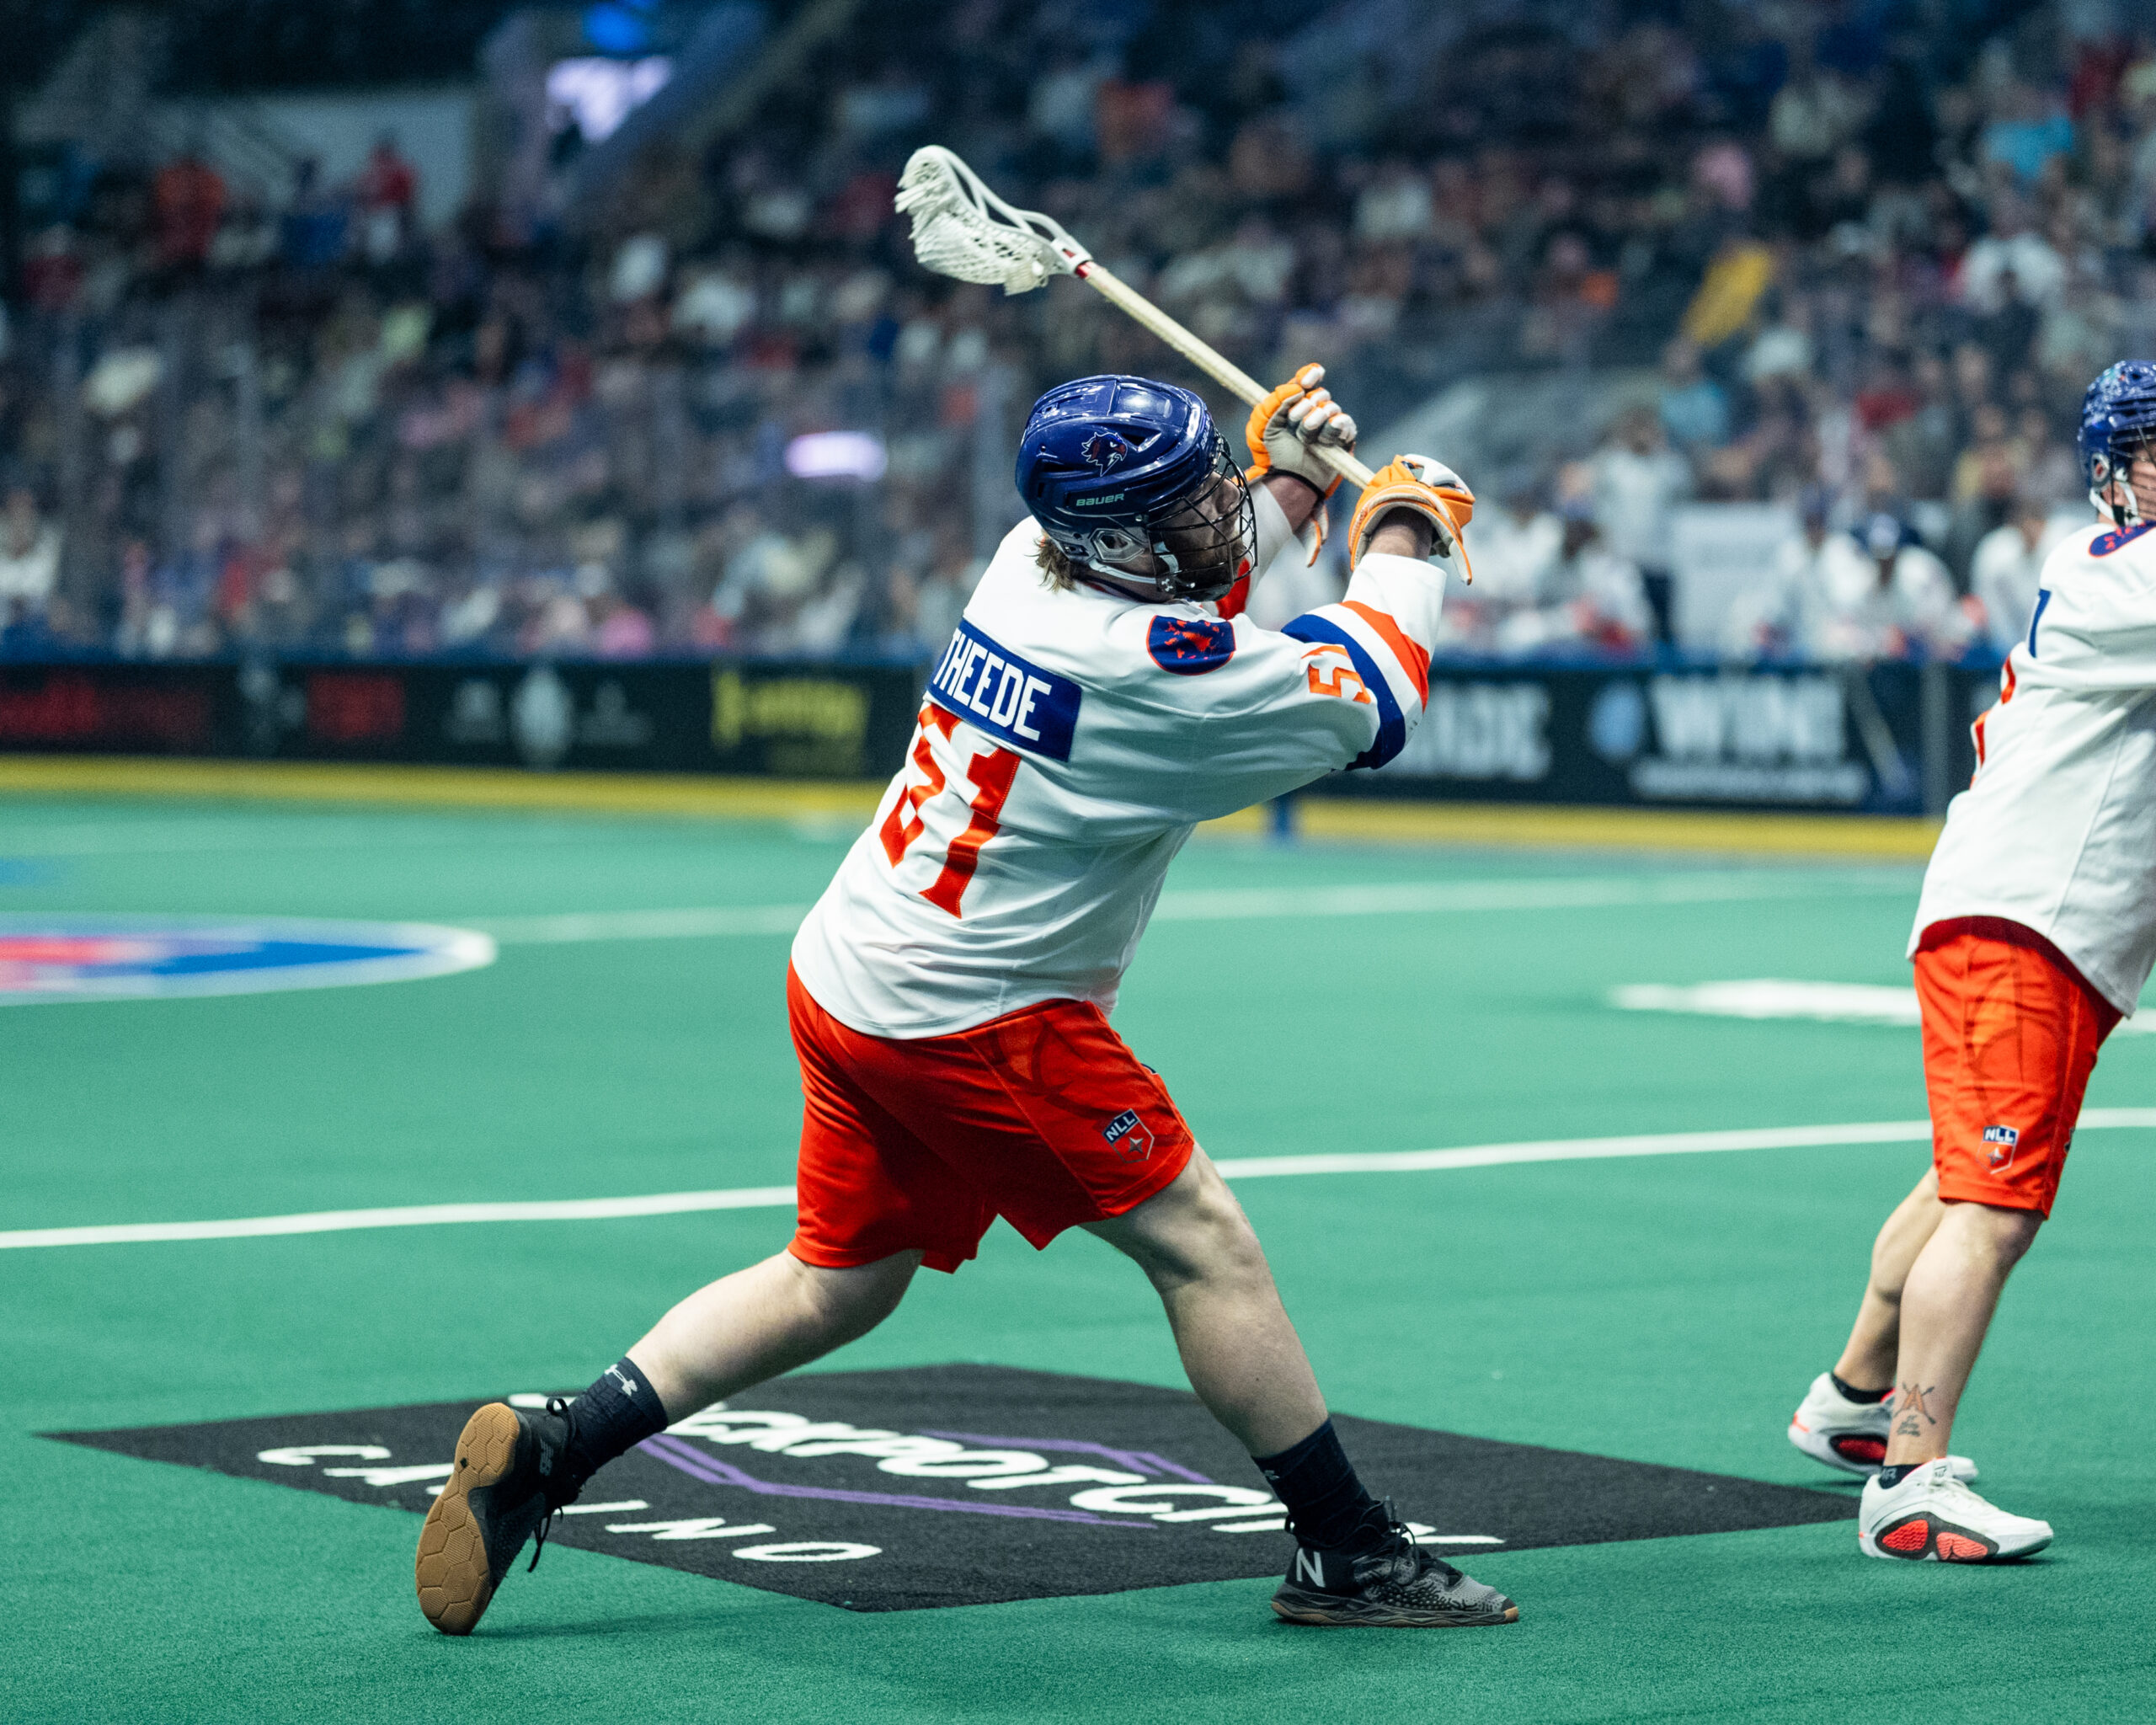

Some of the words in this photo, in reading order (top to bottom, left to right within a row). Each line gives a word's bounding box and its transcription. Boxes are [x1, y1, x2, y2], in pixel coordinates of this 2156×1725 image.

[931, 627, 1053, 742] THEEDE
[1105, 1115, 1136, 1142] NLL
[1983, 1127, 2015, 1143] NLL
[256, 1445, 884, 1565] CAINO
